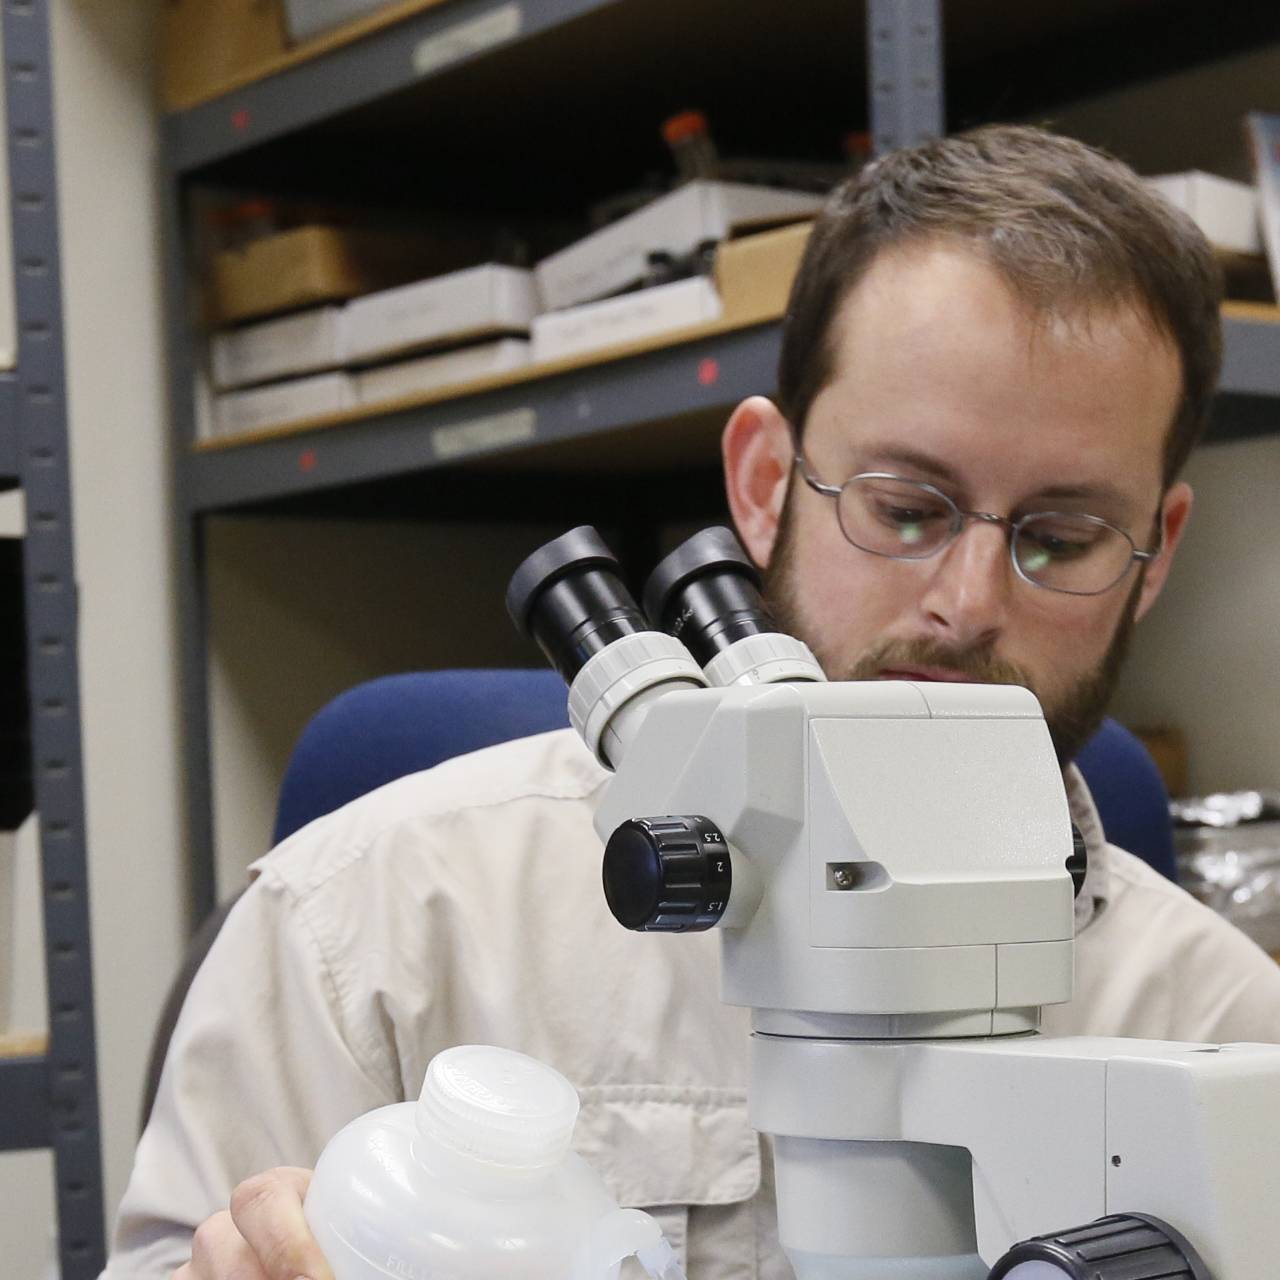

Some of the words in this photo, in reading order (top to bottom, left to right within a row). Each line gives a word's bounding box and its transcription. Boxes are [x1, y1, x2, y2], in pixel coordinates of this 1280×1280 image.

[705, 833, 720, 842] 2.5
[717, 862, 723, 872] 2
[708, 902, 723, 911] 1.5
[385, 1255, 416, 1279] FILL
